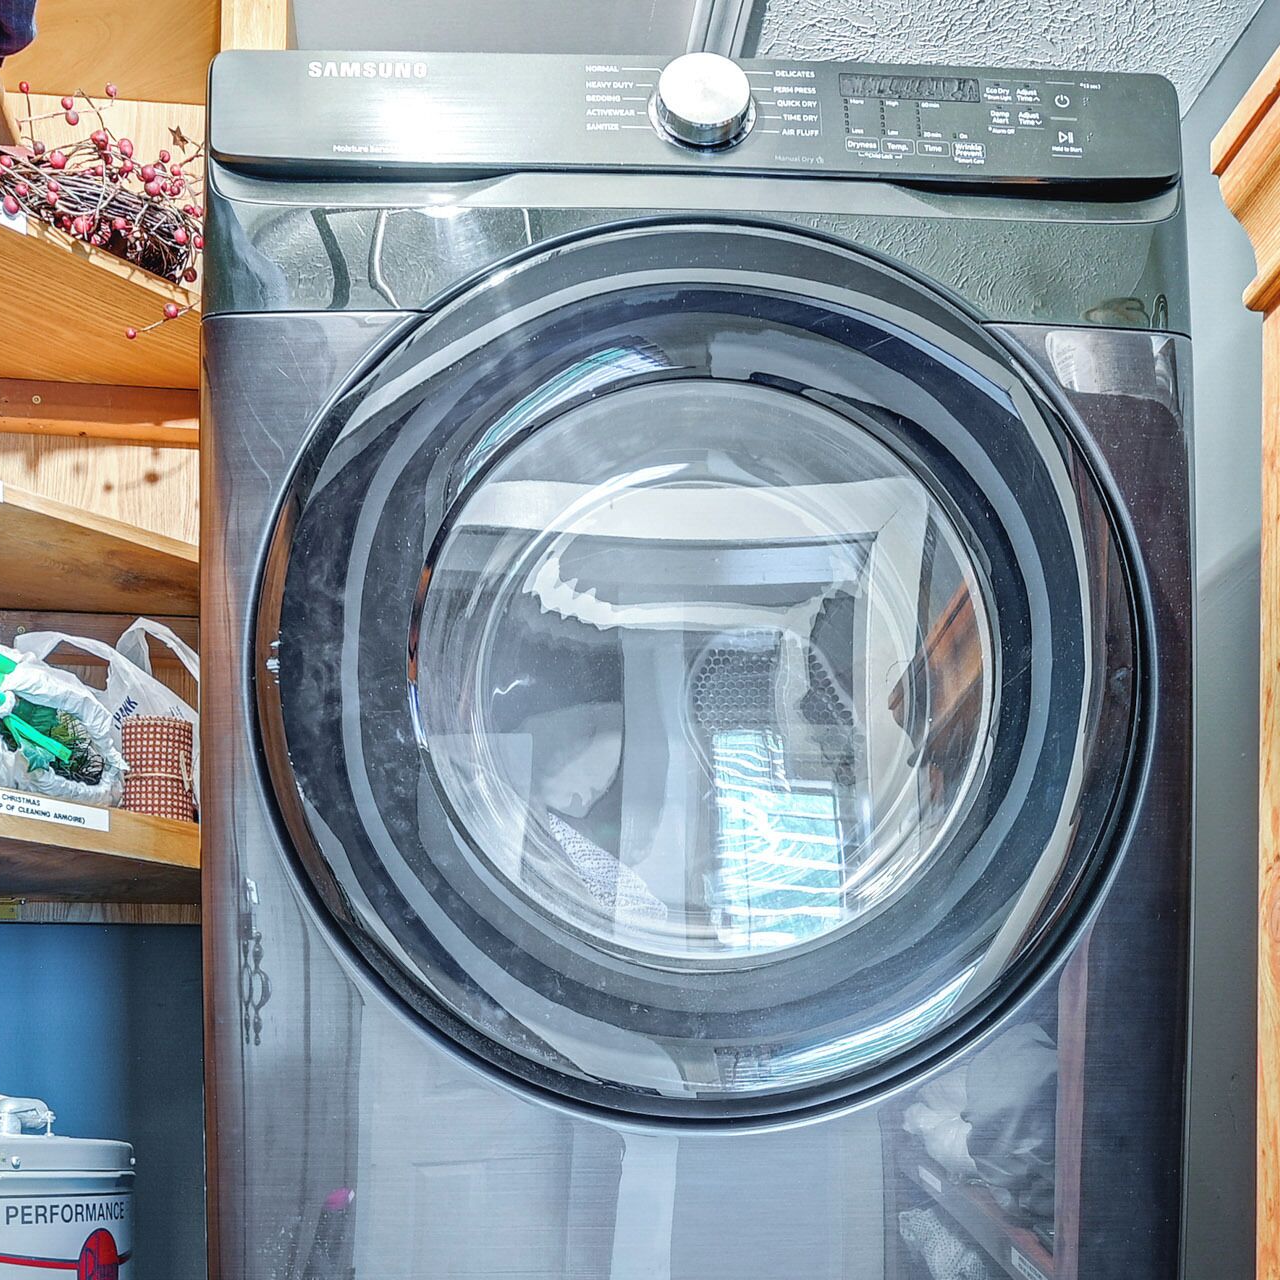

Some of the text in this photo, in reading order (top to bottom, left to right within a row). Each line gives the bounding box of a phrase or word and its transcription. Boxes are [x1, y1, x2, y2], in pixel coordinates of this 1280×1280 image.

[307, 61, 428, 78] SAMSUNG
[585, 65, 620, 73] NORMAL
[775, 70, 815, 78] DELICATES
[585, 81, 634, 89] HEAVY DUTY
[773, 86, 793, 94] PERM
[777, 100, 801, 108] QUICK
[802, 114, 818, 122] DRY
[847, 140, 877, 149] Dryness
[1, 792, 41, 807] CHRISTMAS
[18, 806, 51, 818] CLEANING
[5, 1201, 125, 1225] PERFORMANCE
